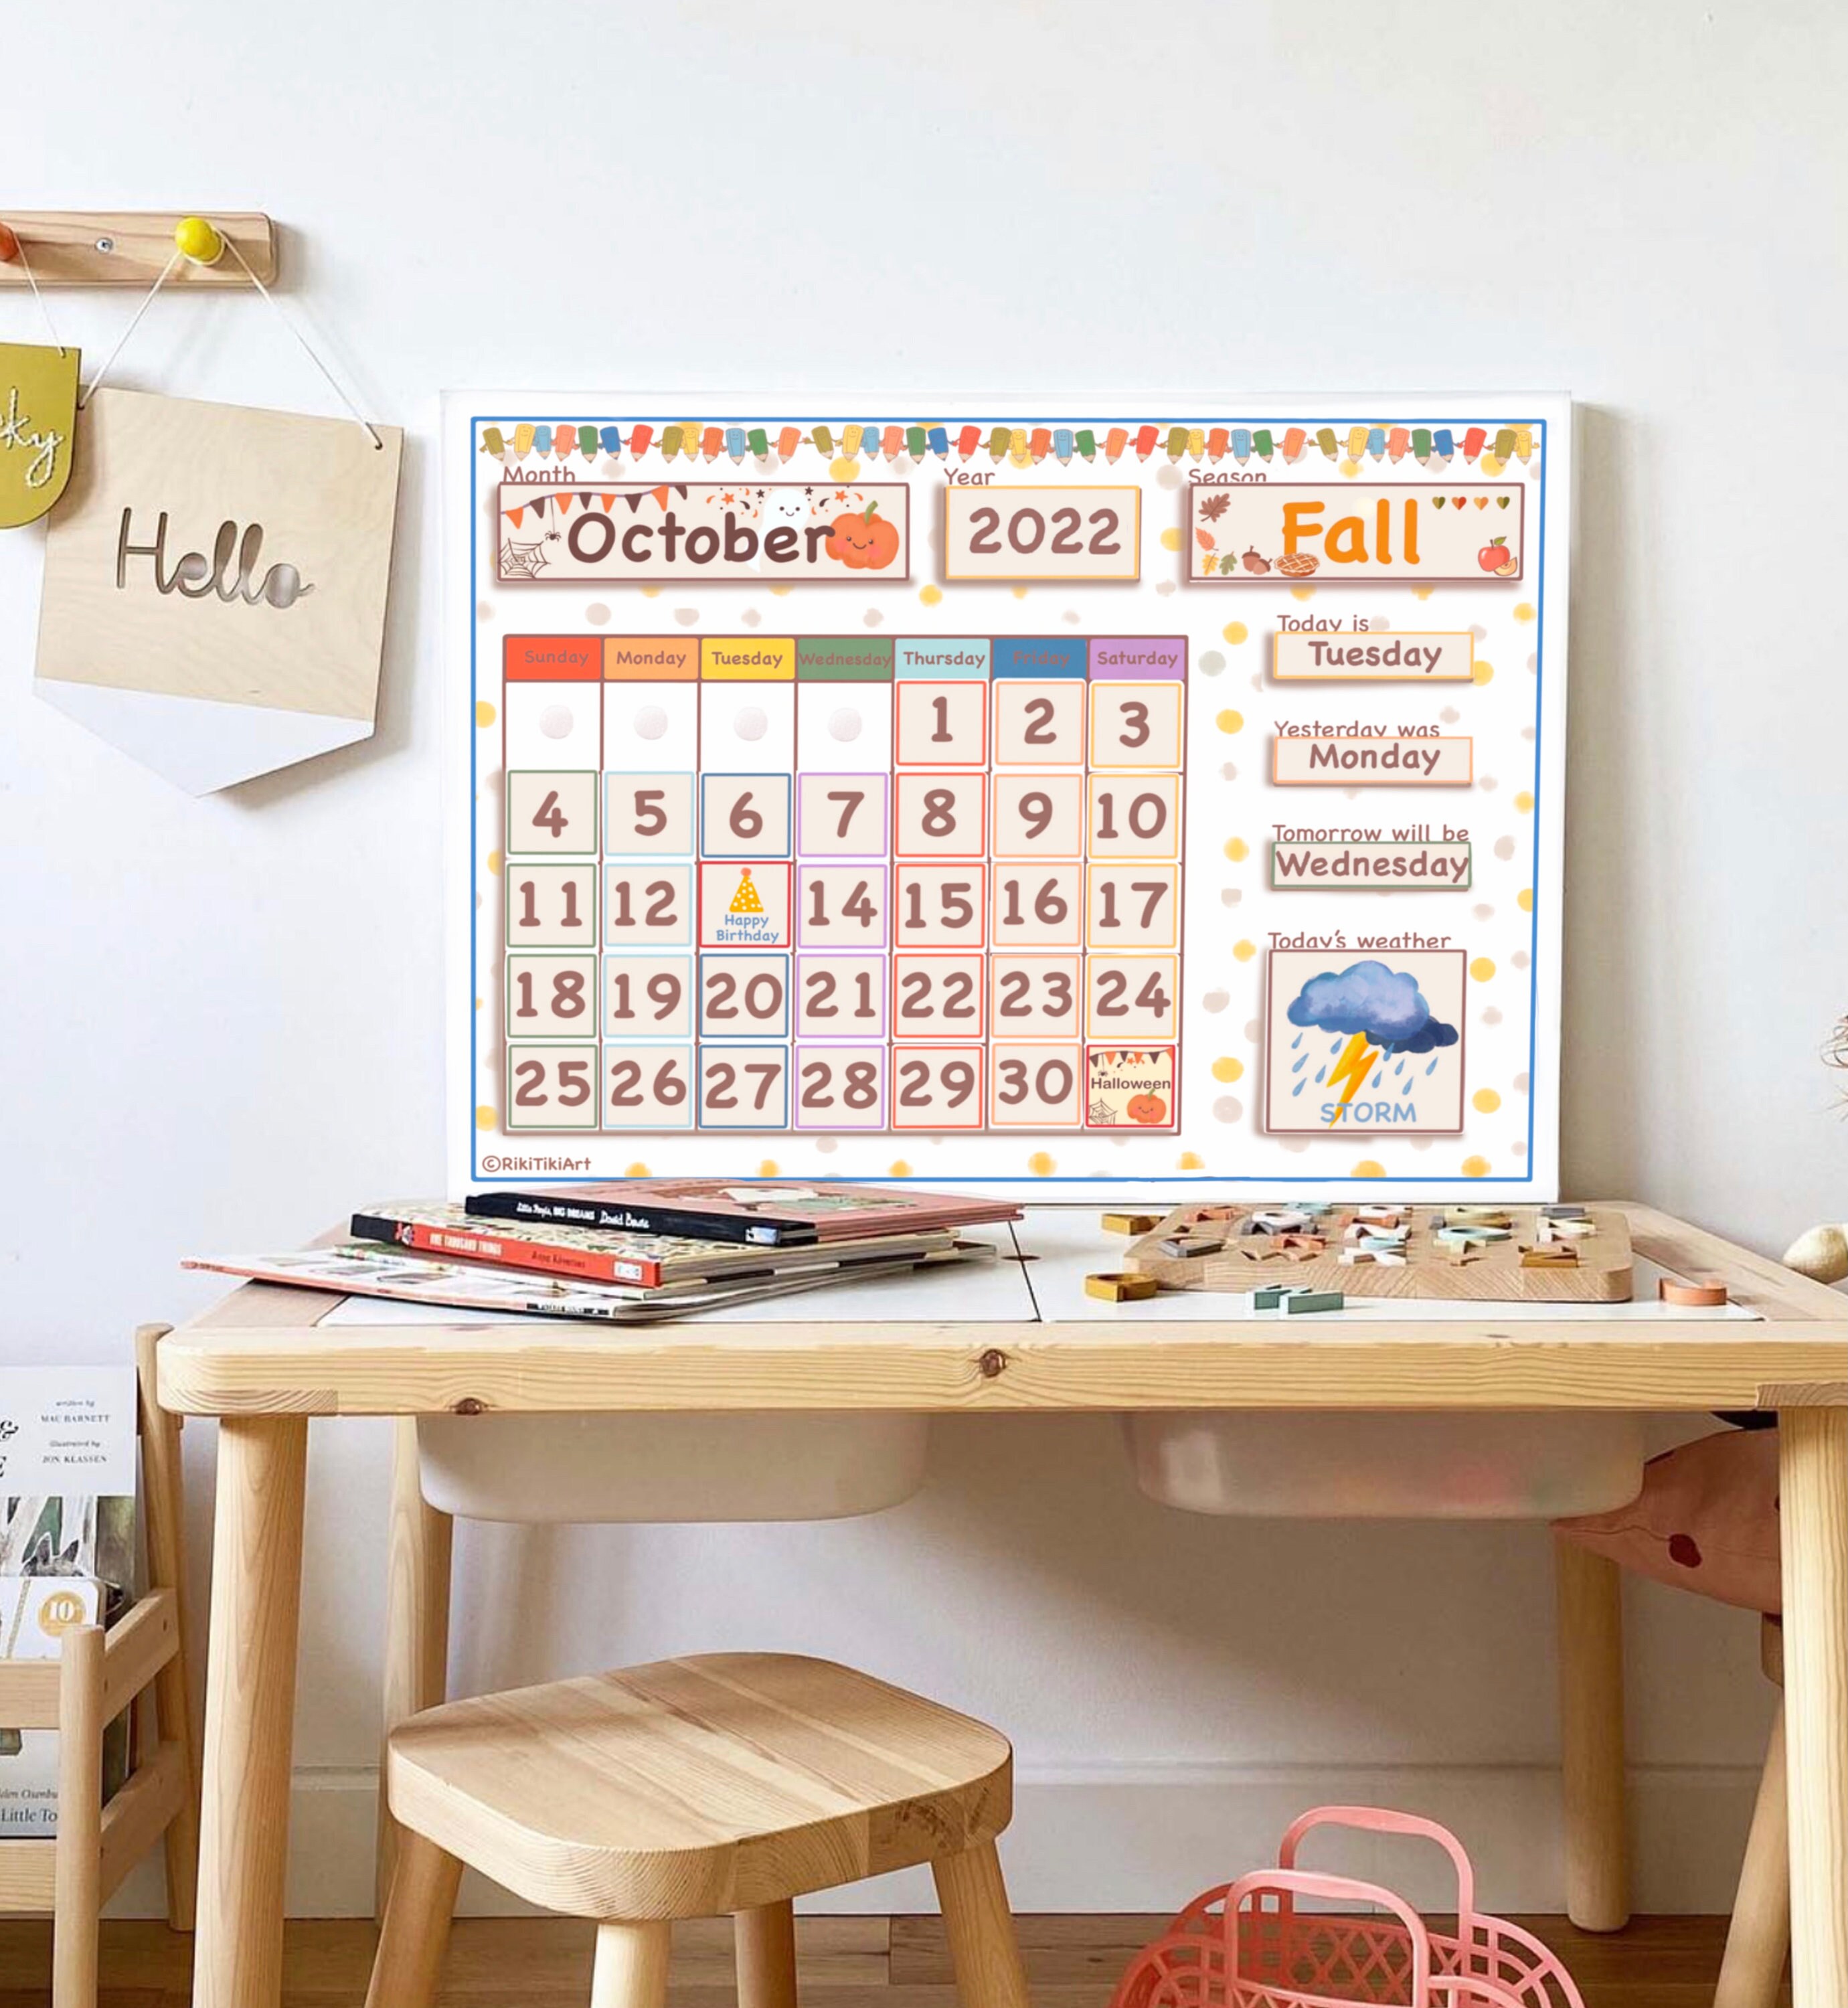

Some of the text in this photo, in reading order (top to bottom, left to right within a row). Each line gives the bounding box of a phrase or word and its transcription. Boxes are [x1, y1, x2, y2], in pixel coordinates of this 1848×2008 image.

[0, 386, 66, 489] ky
[503, 466, 575, 481] Month
[944, 468, 995, 485] Year
[1189, 469, 1266, 483] Season
[568, 511, 836, 564] October
[969, 507, 1121, 555] 2022
[1282, 499, 1420, 565] Fall
[116, 507, 315, 609] Hello
[1277, 614, 1369, 632] Today is
[525, 650, 1177, 669] Sunday Monday Tuesday Wednesday Thursday Friday Saturday
[1308, 640, 1442, 673] Tuesday
[931, 696, 1150, 748] 1 2 3
[1275, 720, 1440, 737] Yesterday was
[1310, 742, 1440, 776] Monday
[532, 788, 1167, 839] 4 5 6 7 8 9 10
[1272, 824, 1468, 842] Tomorrow will be
[1276, 850, 1469, 884] Wednesday
[519, 878, 1168, 928] 11 12 14 15 16 17
[725, 914, 769, 928] Happy
[716, 930, 780, 944] Birthday
[1357, 932, 1451, 948] weather
[517, 970, 1171, 1020] 18 19 20 21 22 23 24
[515, 1059, 1073, 1110] 25 26 27 28 29 30
[1090, 1078, 1171, 1090] Halloween
[1320, 1102, 1417, 1122] STORM
[49, 1600, 76, 1622] 10
[2, 1805, 37, 1822] Little
